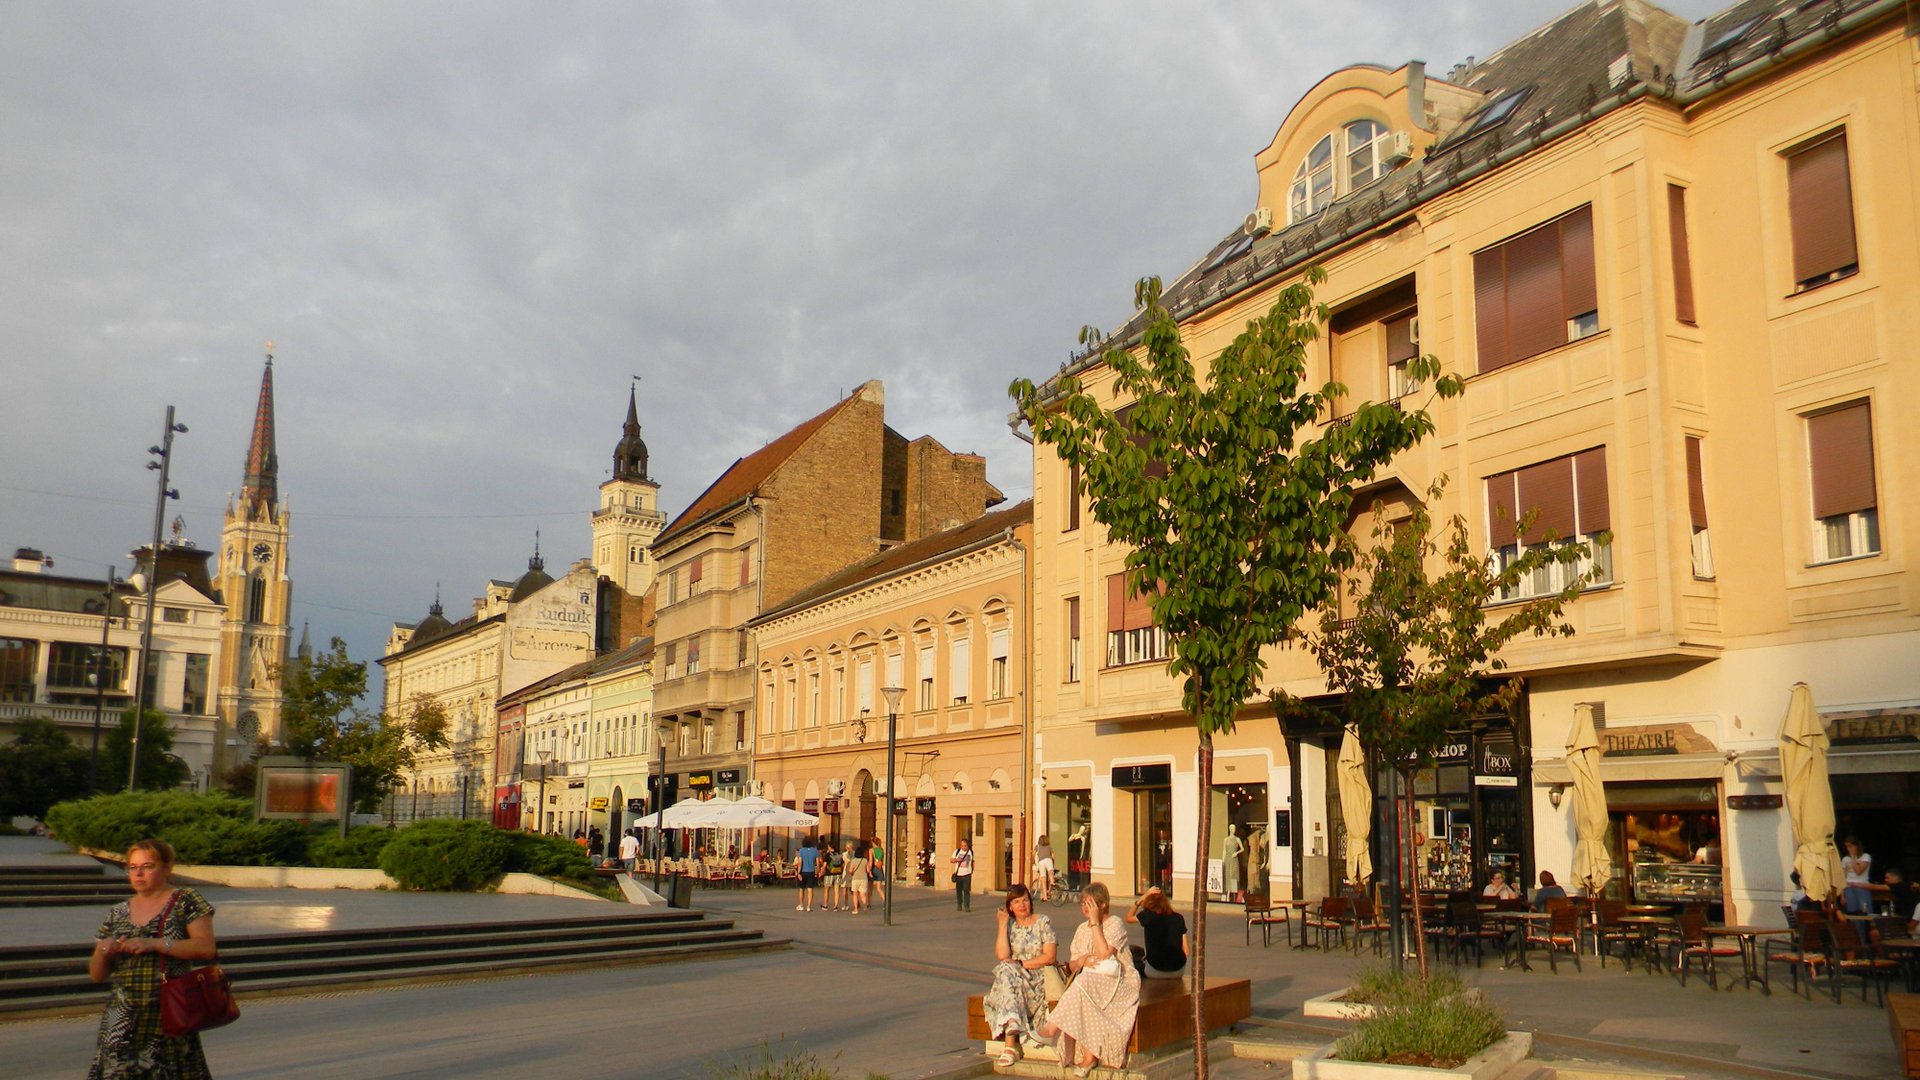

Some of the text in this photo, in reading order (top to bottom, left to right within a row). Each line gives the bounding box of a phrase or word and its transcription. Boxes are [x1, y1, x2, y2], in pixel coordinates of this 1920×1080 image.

[536, 605, 592, 624] Rudnik
[526, 634, 573, 652] Arrow
[1604, 729, 1677, 751] THEATRE
[1490, 756, 1512, 769] BOX
[1070, 860, 1090, 872] SALE
